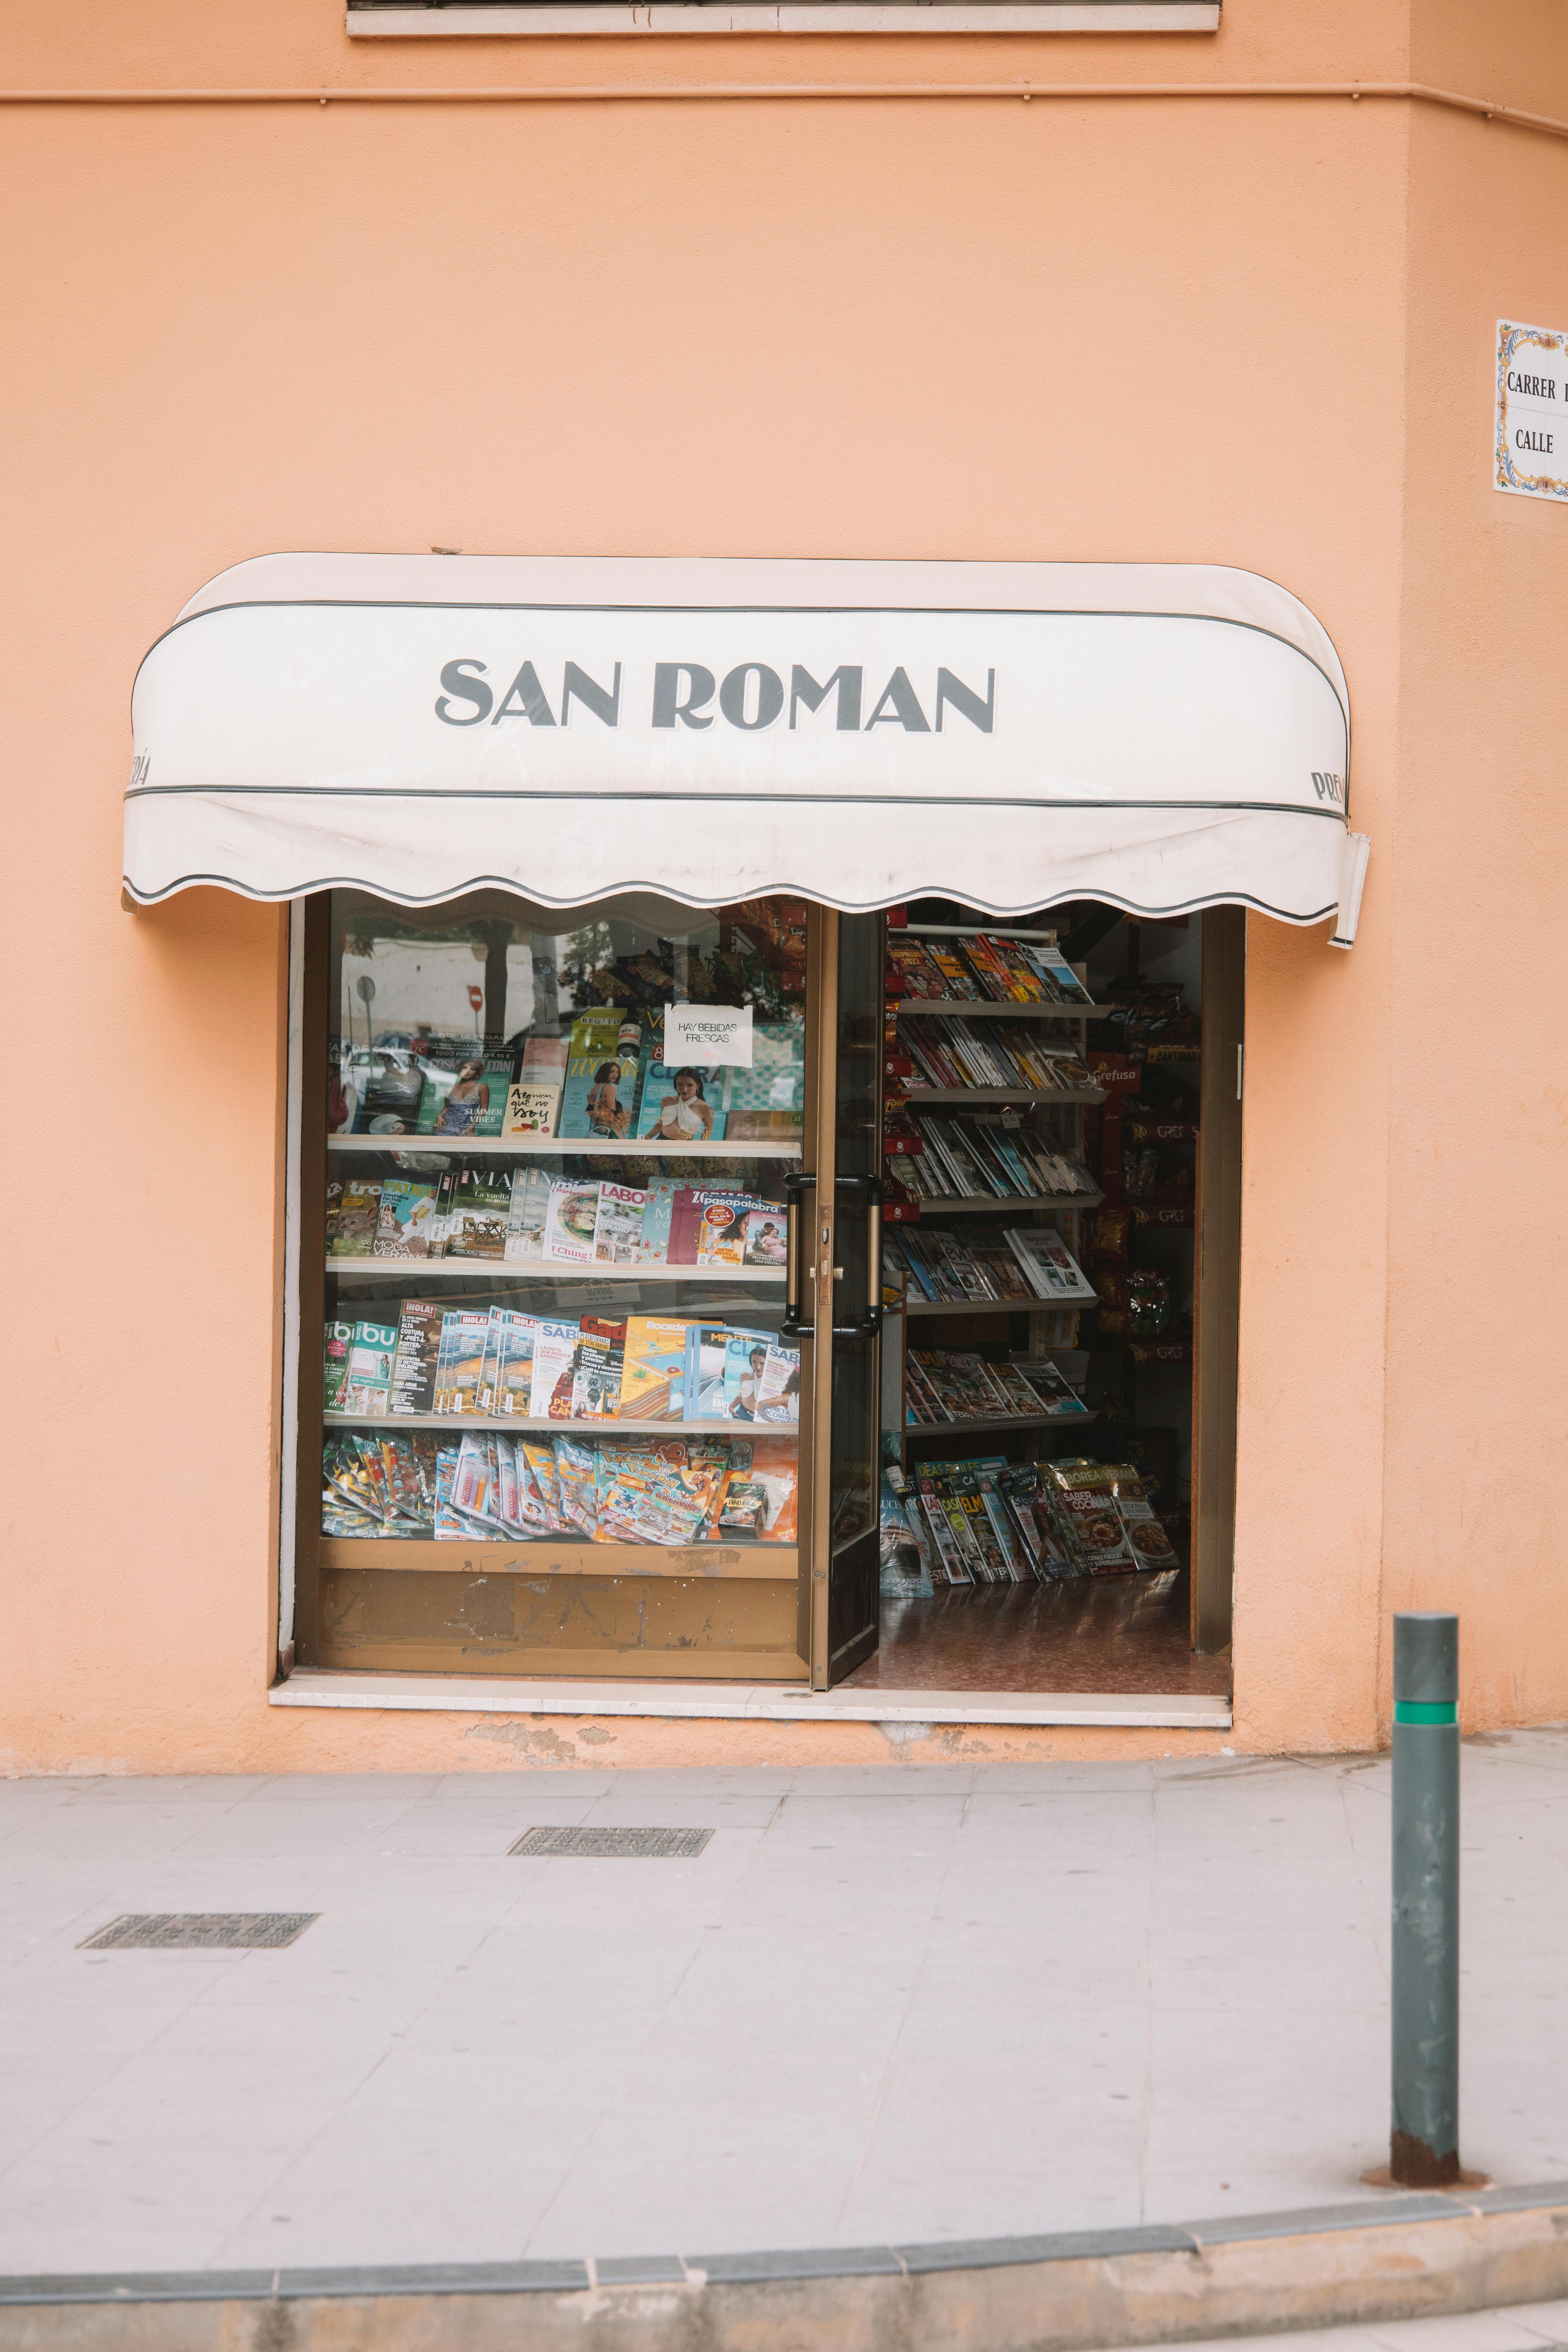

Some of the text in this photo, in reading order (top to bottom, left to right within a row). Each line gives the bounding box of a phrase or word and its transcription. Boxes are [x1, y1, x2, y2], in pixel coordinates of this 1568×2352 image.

[1507, 371, 1556, 400] CARRER
[1516, 429, 1553, 453] CALLE
[434, 658, 995, 733] SAN ROMAN
[679, 1023, 737, 1032] HAY BEBIDAS
[686, 1034, 729, 1043] FRESCAS
[650, 1062, 720, 1084] CLRA
[1093, 1069, 1135, 1081] Grefusa
[511, 1099, 530, 1114] que
[513, 1108, 549, 1124] soy
[472, 1170, 512, 1190] VIA
[350, 1182, 382, 1195] tro
[556, 1188, 594, 1198] Horóscopo
[602, 1184, 646, 1205] LABO
[704, 1197, 779, 1213] pasapalabra
[599, 1222, 630, 1233] VERANO
[600, 1218, 623, 1227] MESAS
[374, 1240, 410, 1253] MODA
[557, 1247, 587, 1260] Ching
[406, 1303, 433, 1314] ¡HOLA!
[462, 1315, 488, 1325] ¡HOLA!
[513, 1316, 538, 1328] ¡HOLA!
[646, 1321, 694, 1331] Rockde
[363, 1323, 395, 1346] bu
[401, 1328, 424, 1337] COSTURA
[542, 1325, 579, 1340] SAB
[580, 1333, 609, 1344] PLATAFORMAS
[585, 1340, 609, 1351] STREAMING
[769, 1346, 800, 1364] SAB
[766, 1369, 784, 1377] INTERNO
[758, 1407, 791, 1421] ARCOÍRIS
[770, 1404, 790, 1416] DIETA
[918, 1464, 943, 1477] IDEAS
[1063, 1491, 1092, 1502] SABER
[1073, 1499, 1112, 1510] COCINAR
